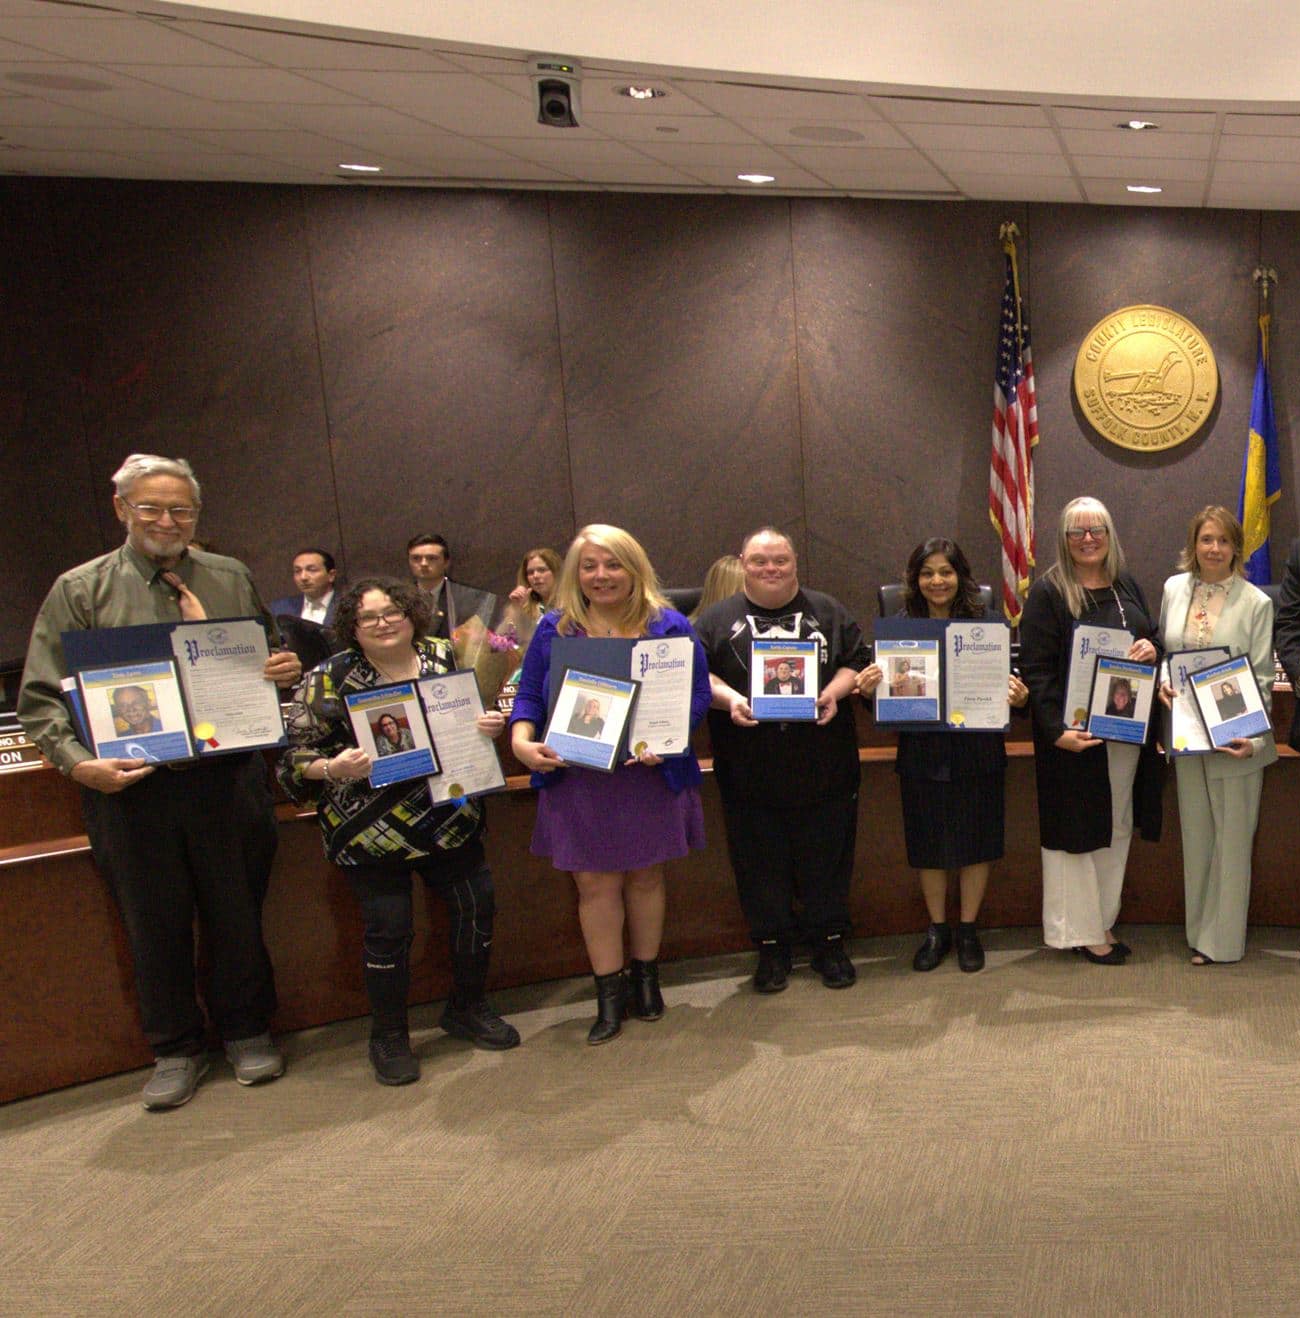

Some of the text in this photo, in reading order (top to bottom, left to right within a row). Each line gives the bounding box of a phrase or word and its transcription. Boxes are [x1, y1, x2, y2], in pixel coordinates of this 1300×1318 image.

[1086, 313, 1208, 367] COUNTY LEGISLATURE
[1084, 386, 1129, 440] SUFFOLK
[1132, 428, 1189, 446] COUNTY,
[184, 639, 257, 666] Proclamation
[953, 634, 1002, 656] Proclamation
[640, 653, 685, 677] Proclamation
[425, 697, 471, 713] roclamation
